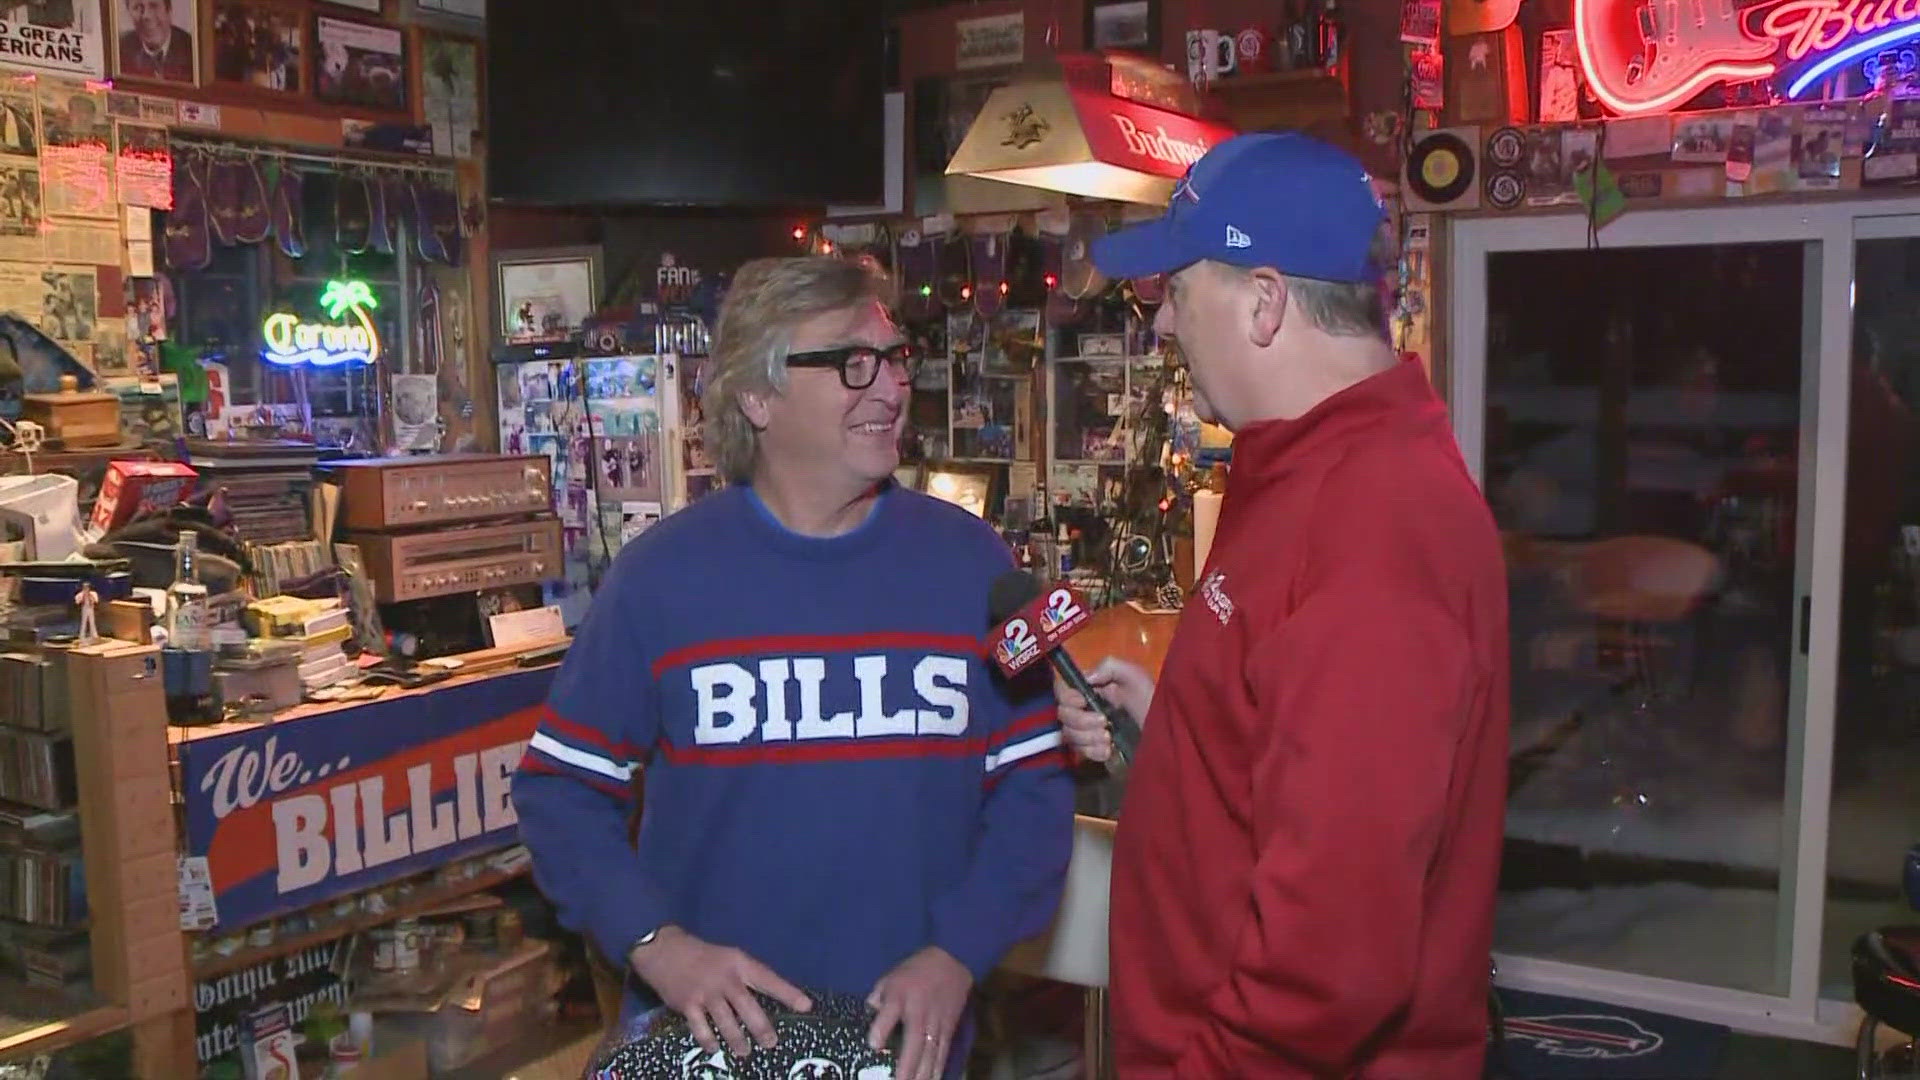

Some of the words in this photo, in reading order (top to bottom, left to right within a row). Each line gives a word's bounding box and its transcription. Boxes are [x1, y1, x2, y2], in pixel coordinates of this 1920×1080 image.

[20, 26, 83, 47] GREAT
[264, 312, 370, 356] Corona
[1049, 589, 1081, 623] 2
[1005, 618, 1038, 654] 2
[690, 654, 970, 745] BILLS
[271, 739, 530, 895] BILLIE
